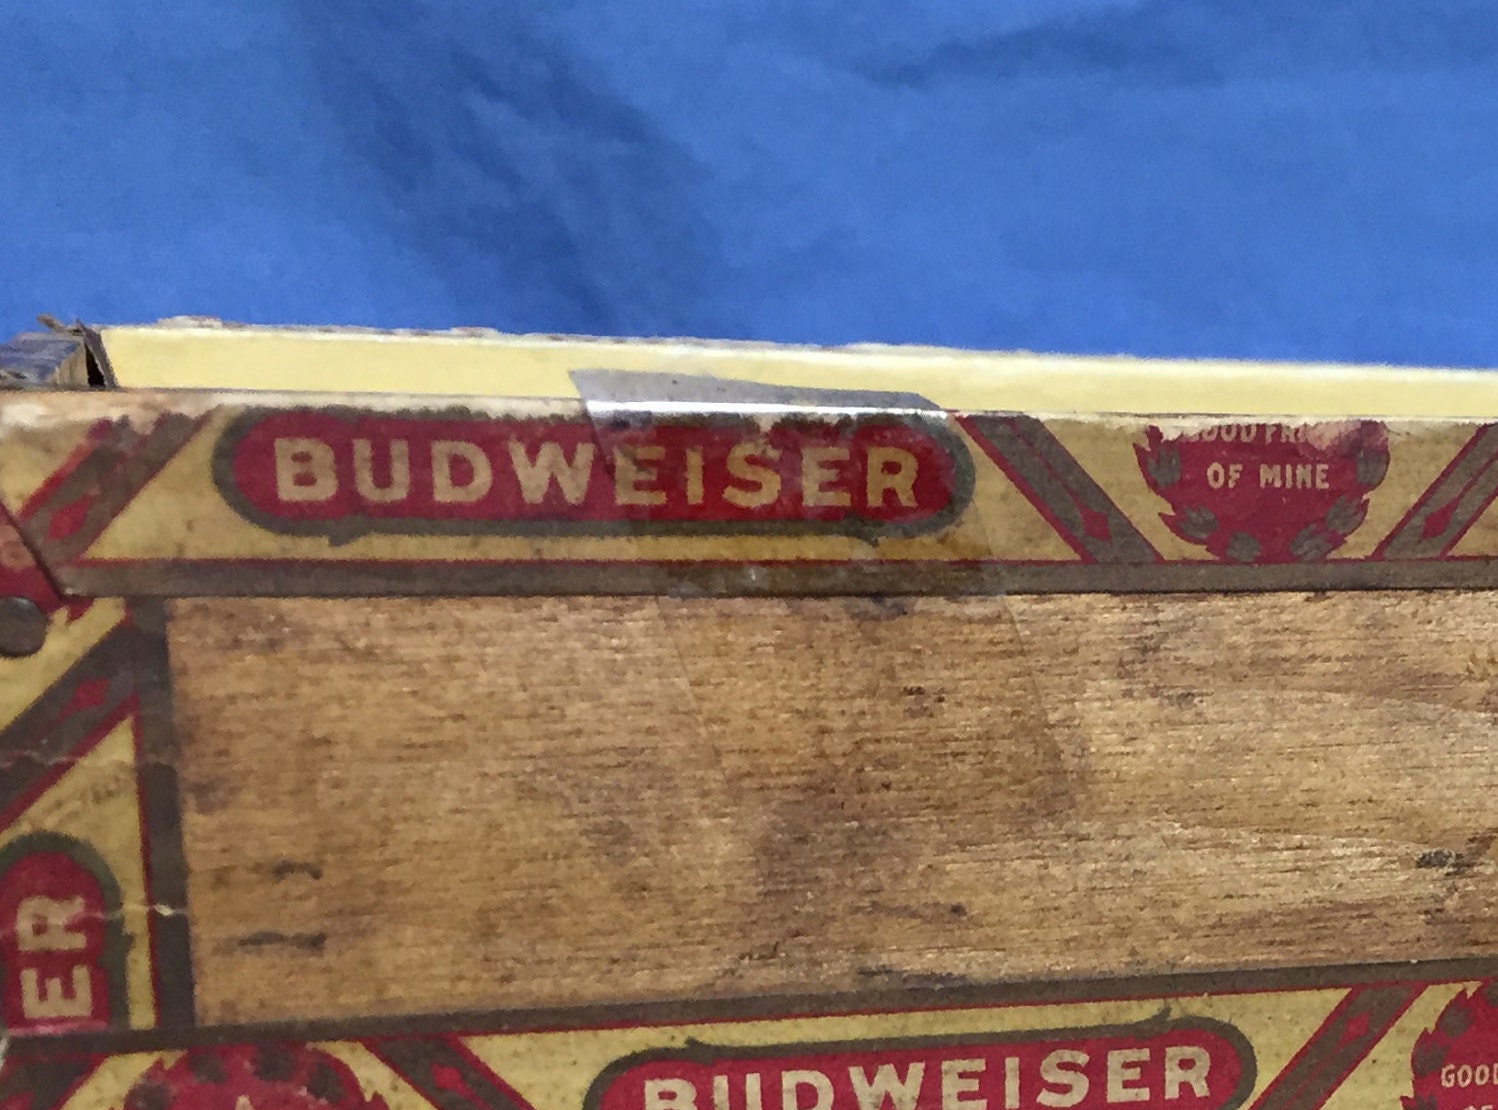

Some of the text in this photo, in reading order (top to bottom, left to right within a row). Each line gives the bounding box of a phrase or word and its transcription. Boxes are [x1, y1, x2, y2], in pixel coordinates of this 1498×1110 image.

[273, 437, 919, 508] BUDWEISER
[1206, 462, 1330, 490] OF MINE
